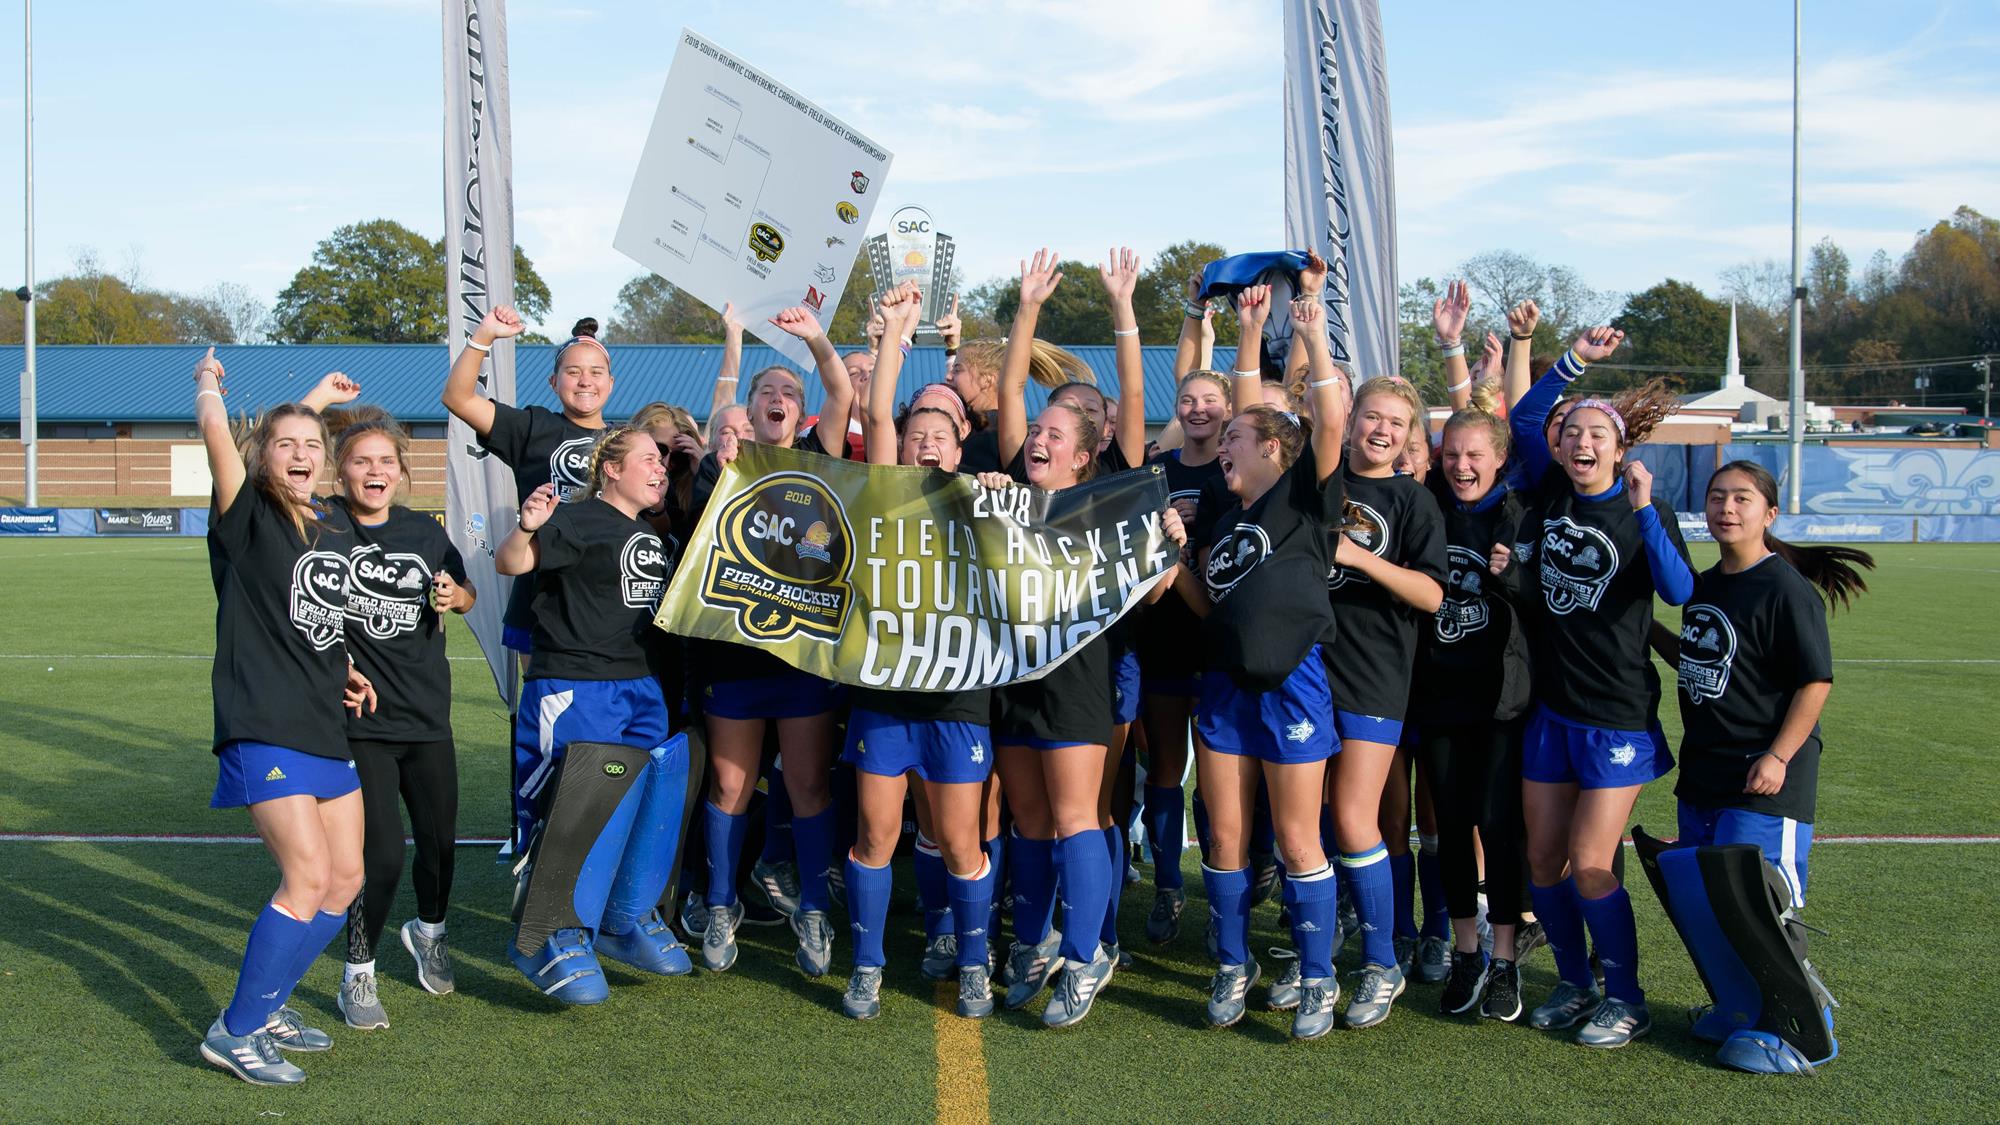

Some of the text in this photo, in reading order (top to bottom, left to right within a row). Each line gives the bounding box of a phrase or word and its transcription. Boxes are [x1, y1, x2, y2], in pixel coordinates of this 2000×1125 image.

[685, 34, 700, 49] 2018
[699, 43, 718, 60] SOUTH
[718, 53, 745, 75] ATLANTIC
[744, 68, 778, 96] CONFERENCE
[778, 89, 809, 114] CAROLINAS
[808, 107, 824, 123] FIELD
[823, 115, 845, 136] HOCKEY
[844, 131, 887, 162] CHAMPIONSHIP
[757, 227, 770, 240] SAC
[898, 220, 930, 233] SAC
[784, 490, 812, 506] 2018
[972, 479, 1031, 528] 2018
[107, 515, 129, 524] MAKE
[142, 511, 172, 528] YOURS
[748, 510, 796, 546] SAC
[870, 510, 1163, 565] FIELD HOCKEY
[1565, 526, 1584, 539] 2018
[1545, 532, 1574, 558] SAC
[358, 560, 398, 584] SAC
[1208, 552, 1233, 577] SAC
[631, 581, 661, 590] FIELD
[721, 567, 840, 608] FIELD HOCKEY
[866, 550, 1168, 622] TOURNAMENT
[300, 599, 328, 617] FIELD
[348, 593, 421, 613] FIELD HOCKEY
[739, 584, 822, 614] CHAMPIONSHIP
[1687, 662, 1721, 678] HOCKEY
[606, 764, 625, 774] OBO
